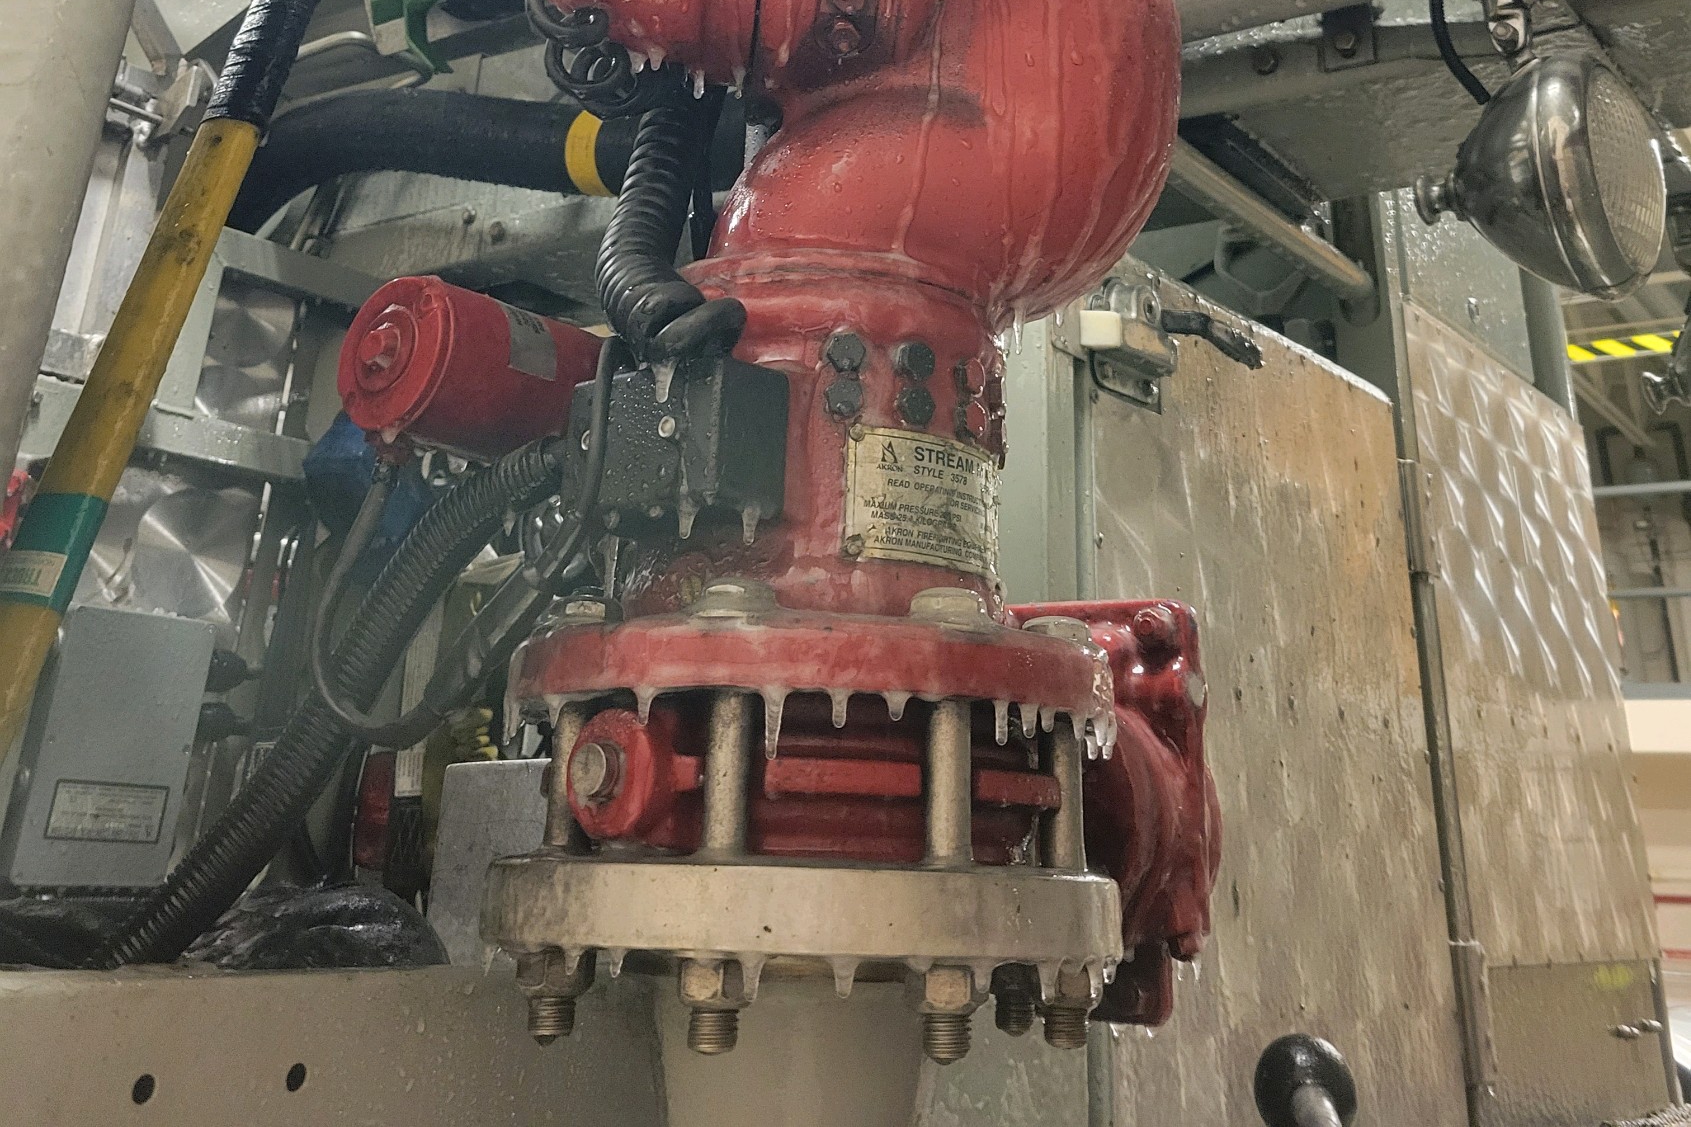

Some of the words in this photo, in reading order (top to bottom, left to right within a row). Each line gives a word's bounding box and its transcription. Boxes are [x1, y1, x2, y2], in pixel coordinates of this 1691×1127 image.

[914, 446, 974, 473] STREAM
[876, 463, 903, 472] AKRON
[914, 465, 944, 480] STYLE
[950, 472, 968, 485] 3578
[887, 478, 911, 489] READ
[898, 503, 939, 517] PRESSURE
[884, 526, 914, 538] AKRON
[873, 535, 904, 546] AKRON
[904, 538, 962, 555] MANUFACTURING
